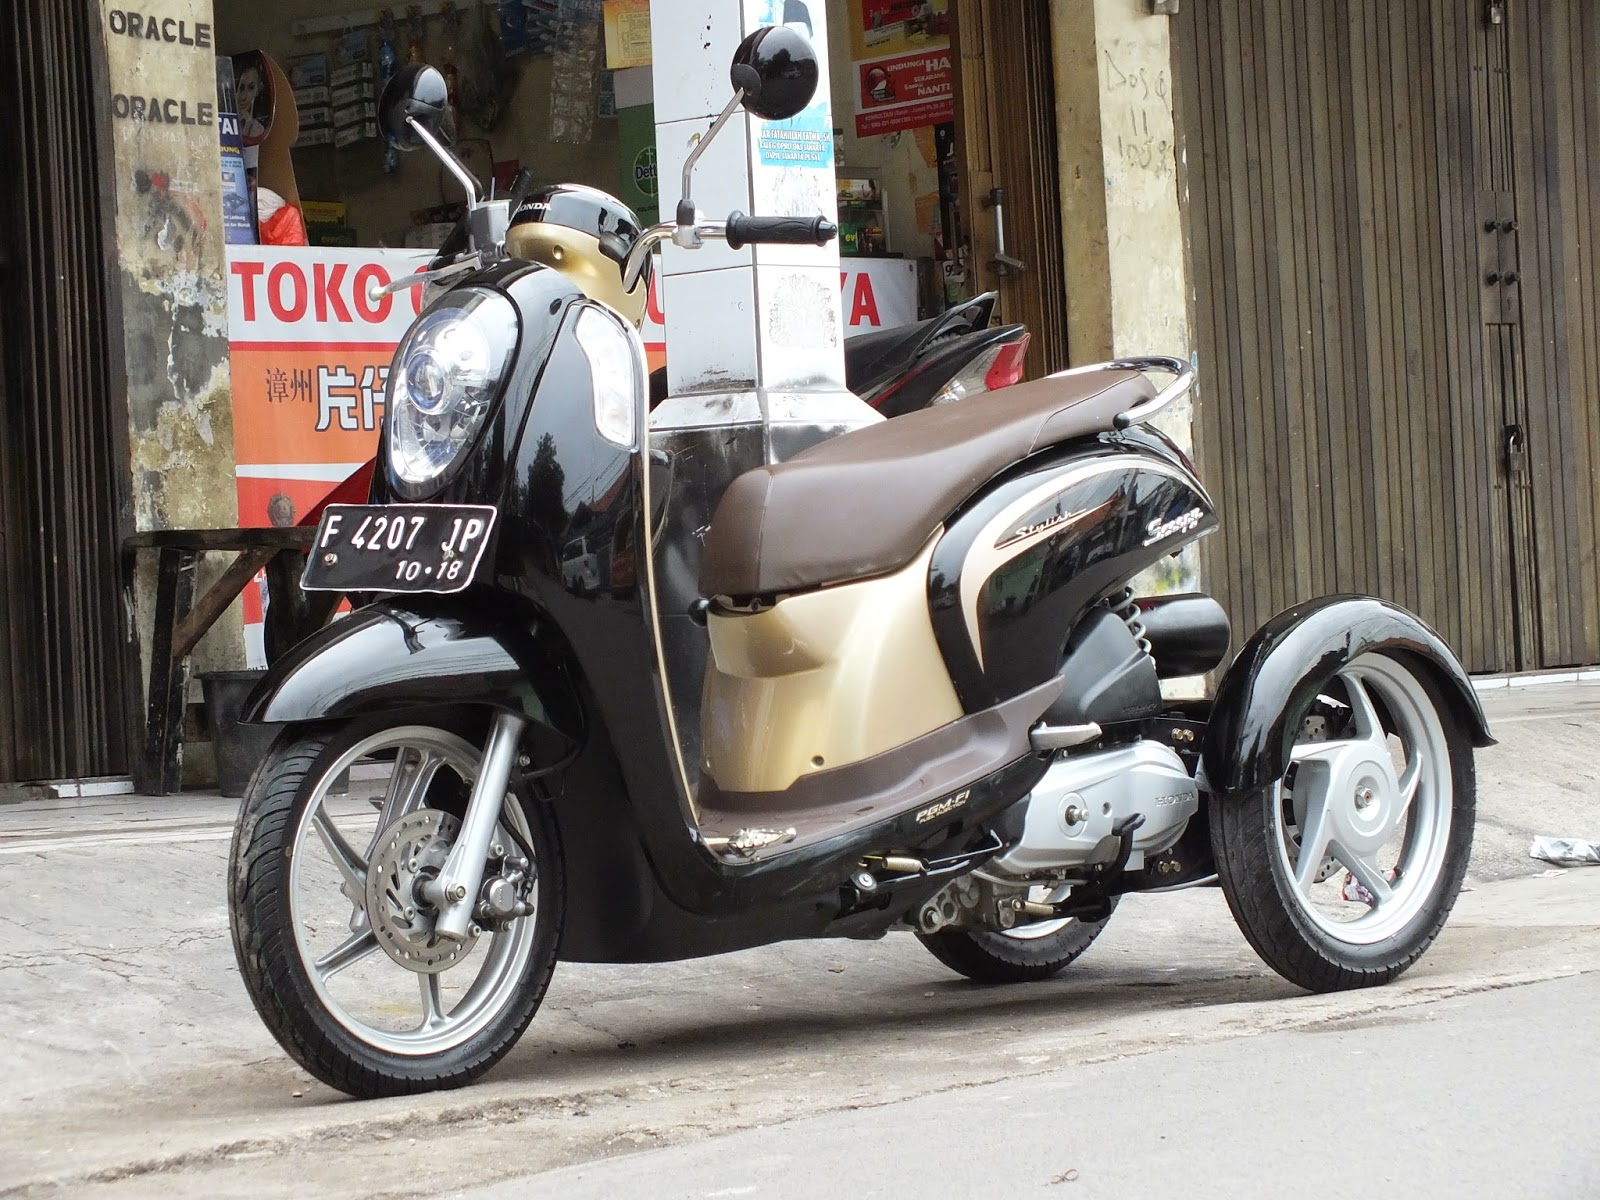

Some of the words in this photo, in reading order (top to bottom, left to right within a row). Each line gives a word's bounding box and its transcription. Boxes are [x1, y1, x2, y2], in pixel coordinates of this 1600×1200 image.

[109, 10, 211, 48] ORACLE
[926, 56, 952, 72] HA
[112, 94, 213, 126] ORACLE
[230, 261, 394, 324] TOKO
[321, 515, 342, 548] F
[351, 515, 425, 550] 4207
[441, 518, 482, 552] JP
[1154, 791, 1195, 807] HONDA
